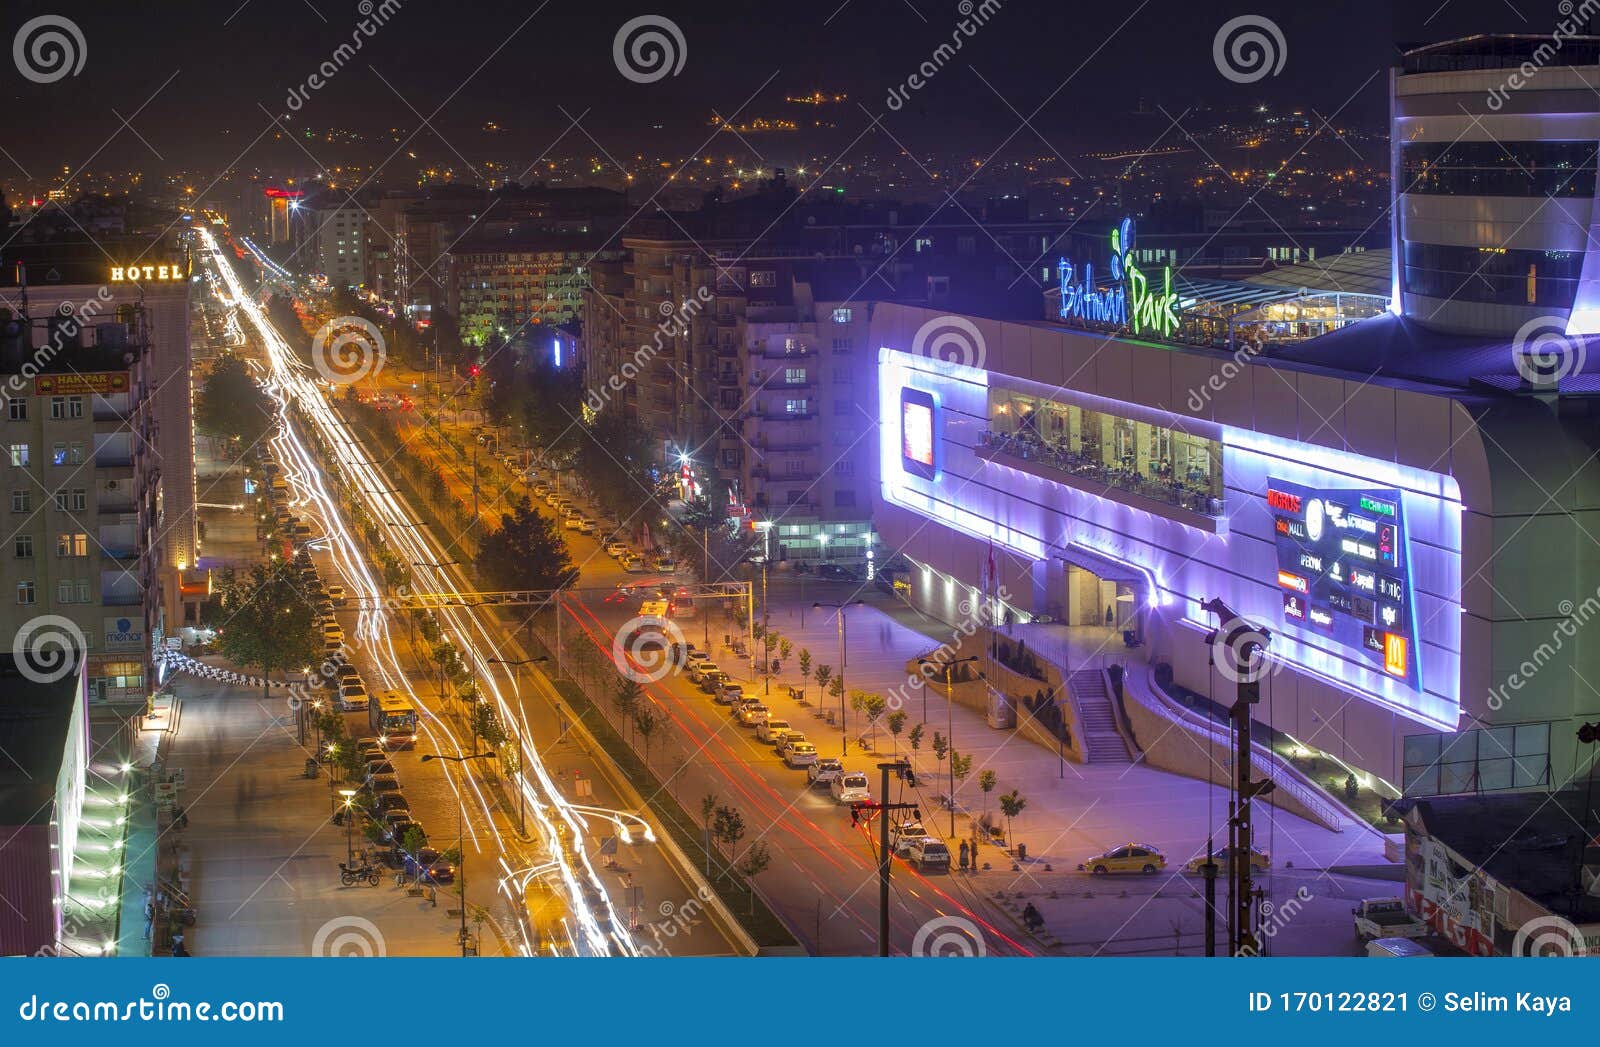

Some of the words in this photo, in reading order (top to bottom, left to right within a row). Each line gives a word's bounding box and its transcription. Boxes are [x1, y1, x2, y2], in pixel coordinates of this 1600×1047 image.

[111, 266, 183, 281] HOTEL
[1059, 257, 1126, 325] Batman
[1130, 265, 1180, 337] Park
